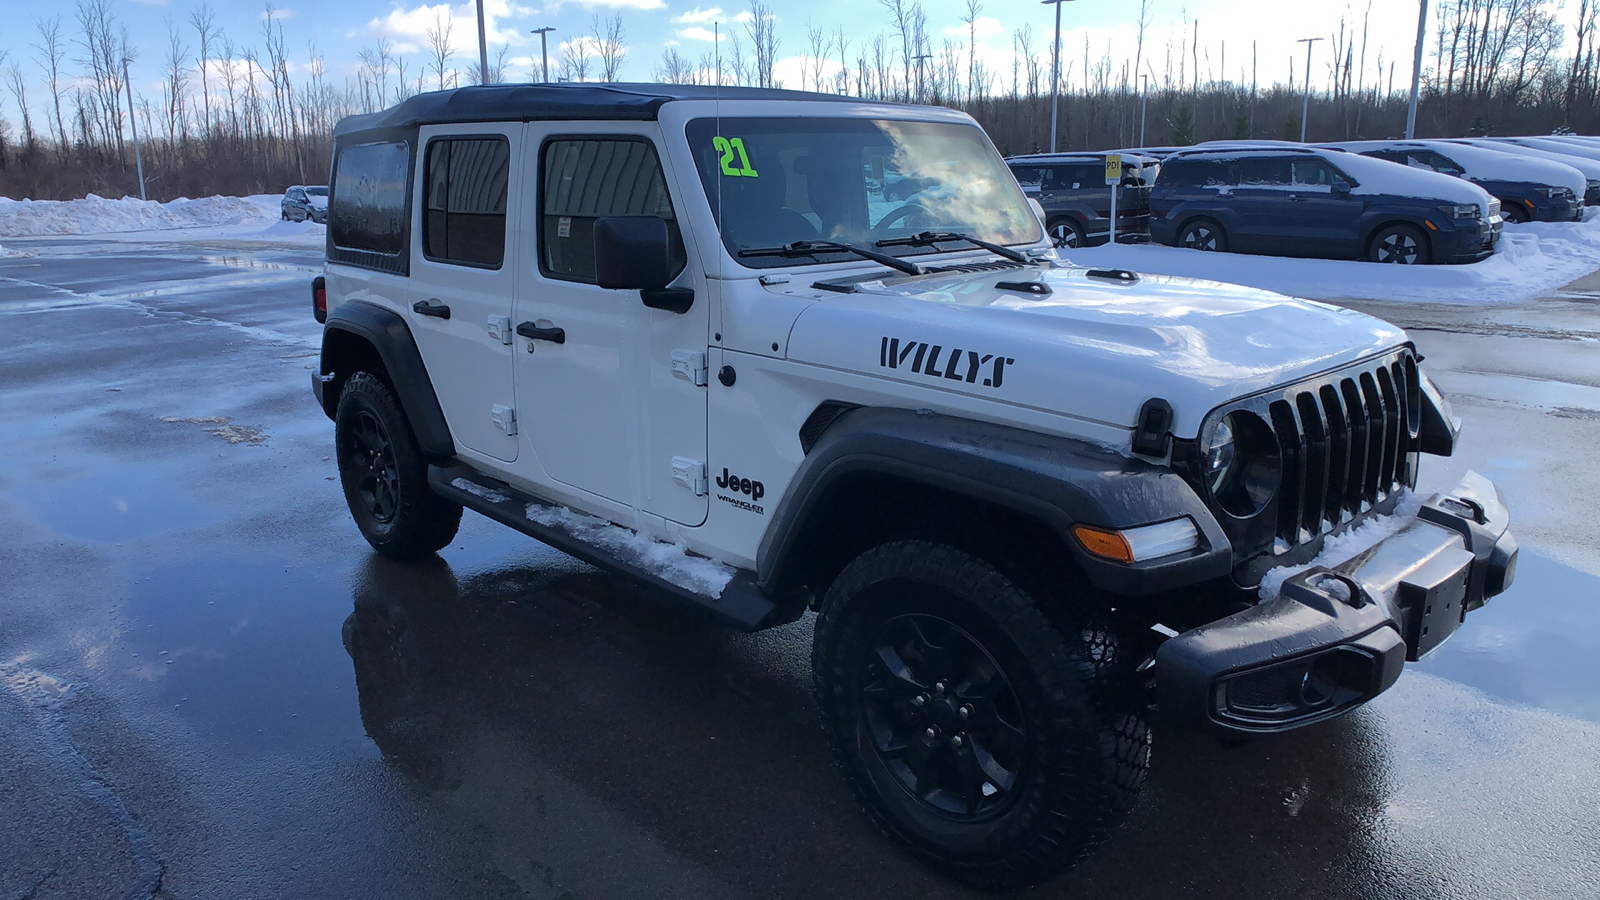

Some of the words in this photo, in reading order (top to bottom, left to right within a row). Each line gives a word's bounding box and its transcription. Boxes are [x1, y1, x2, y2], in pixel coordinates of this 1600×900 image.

[712, 136, 759, 177] 21
[1106, 161, 1120, 169] PDI
[880, 336, 1015, 388] WILLYS
[716, 467, 765, 501] Jeep
[716, 493, 764, 512] WRANGLER
